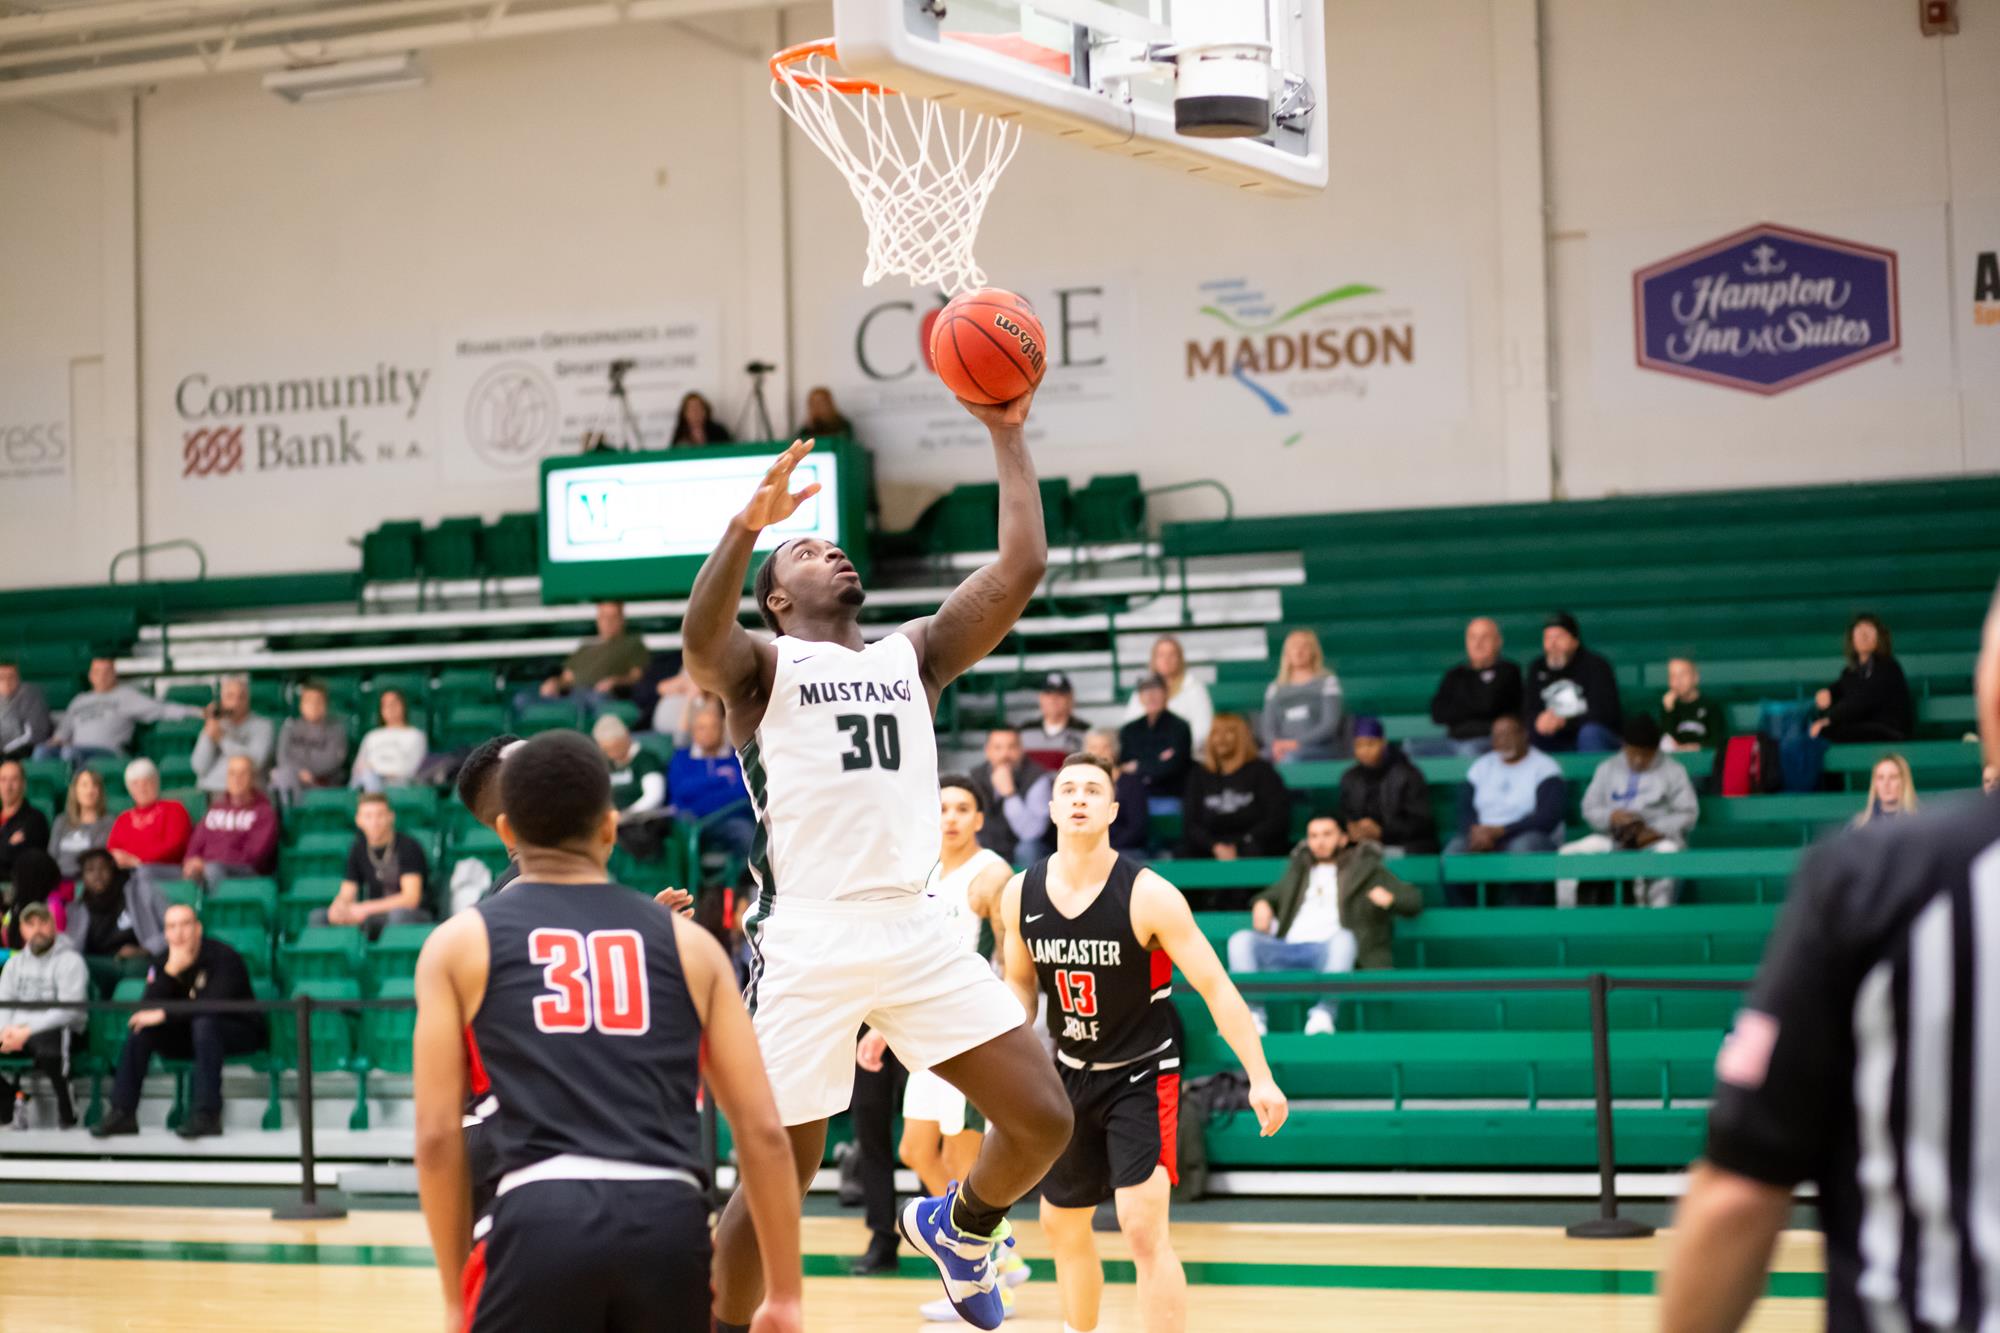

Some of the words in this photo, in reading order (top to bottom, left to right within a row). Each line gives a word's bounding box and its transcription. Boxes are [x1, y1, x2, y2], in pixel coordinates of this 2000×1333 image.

[1671, 272, 1851, 325] Hampton
[993, 312, 1044, 375] Wilson
[1186, 323, 1415, 379] MADISON
[1666, 319, 1753, 363] Inn
[1775, 311, 1871, 353] Suites
[175, 362, 431, 421] Community
[256, 415, 365, 470] Bank
[835, 712, 901, 773] 30
[1026, 937, 1121, 967] LANCASTER
[527, 927, 651, 1037] 30
[1055, 968, 1098, 1017] 13
